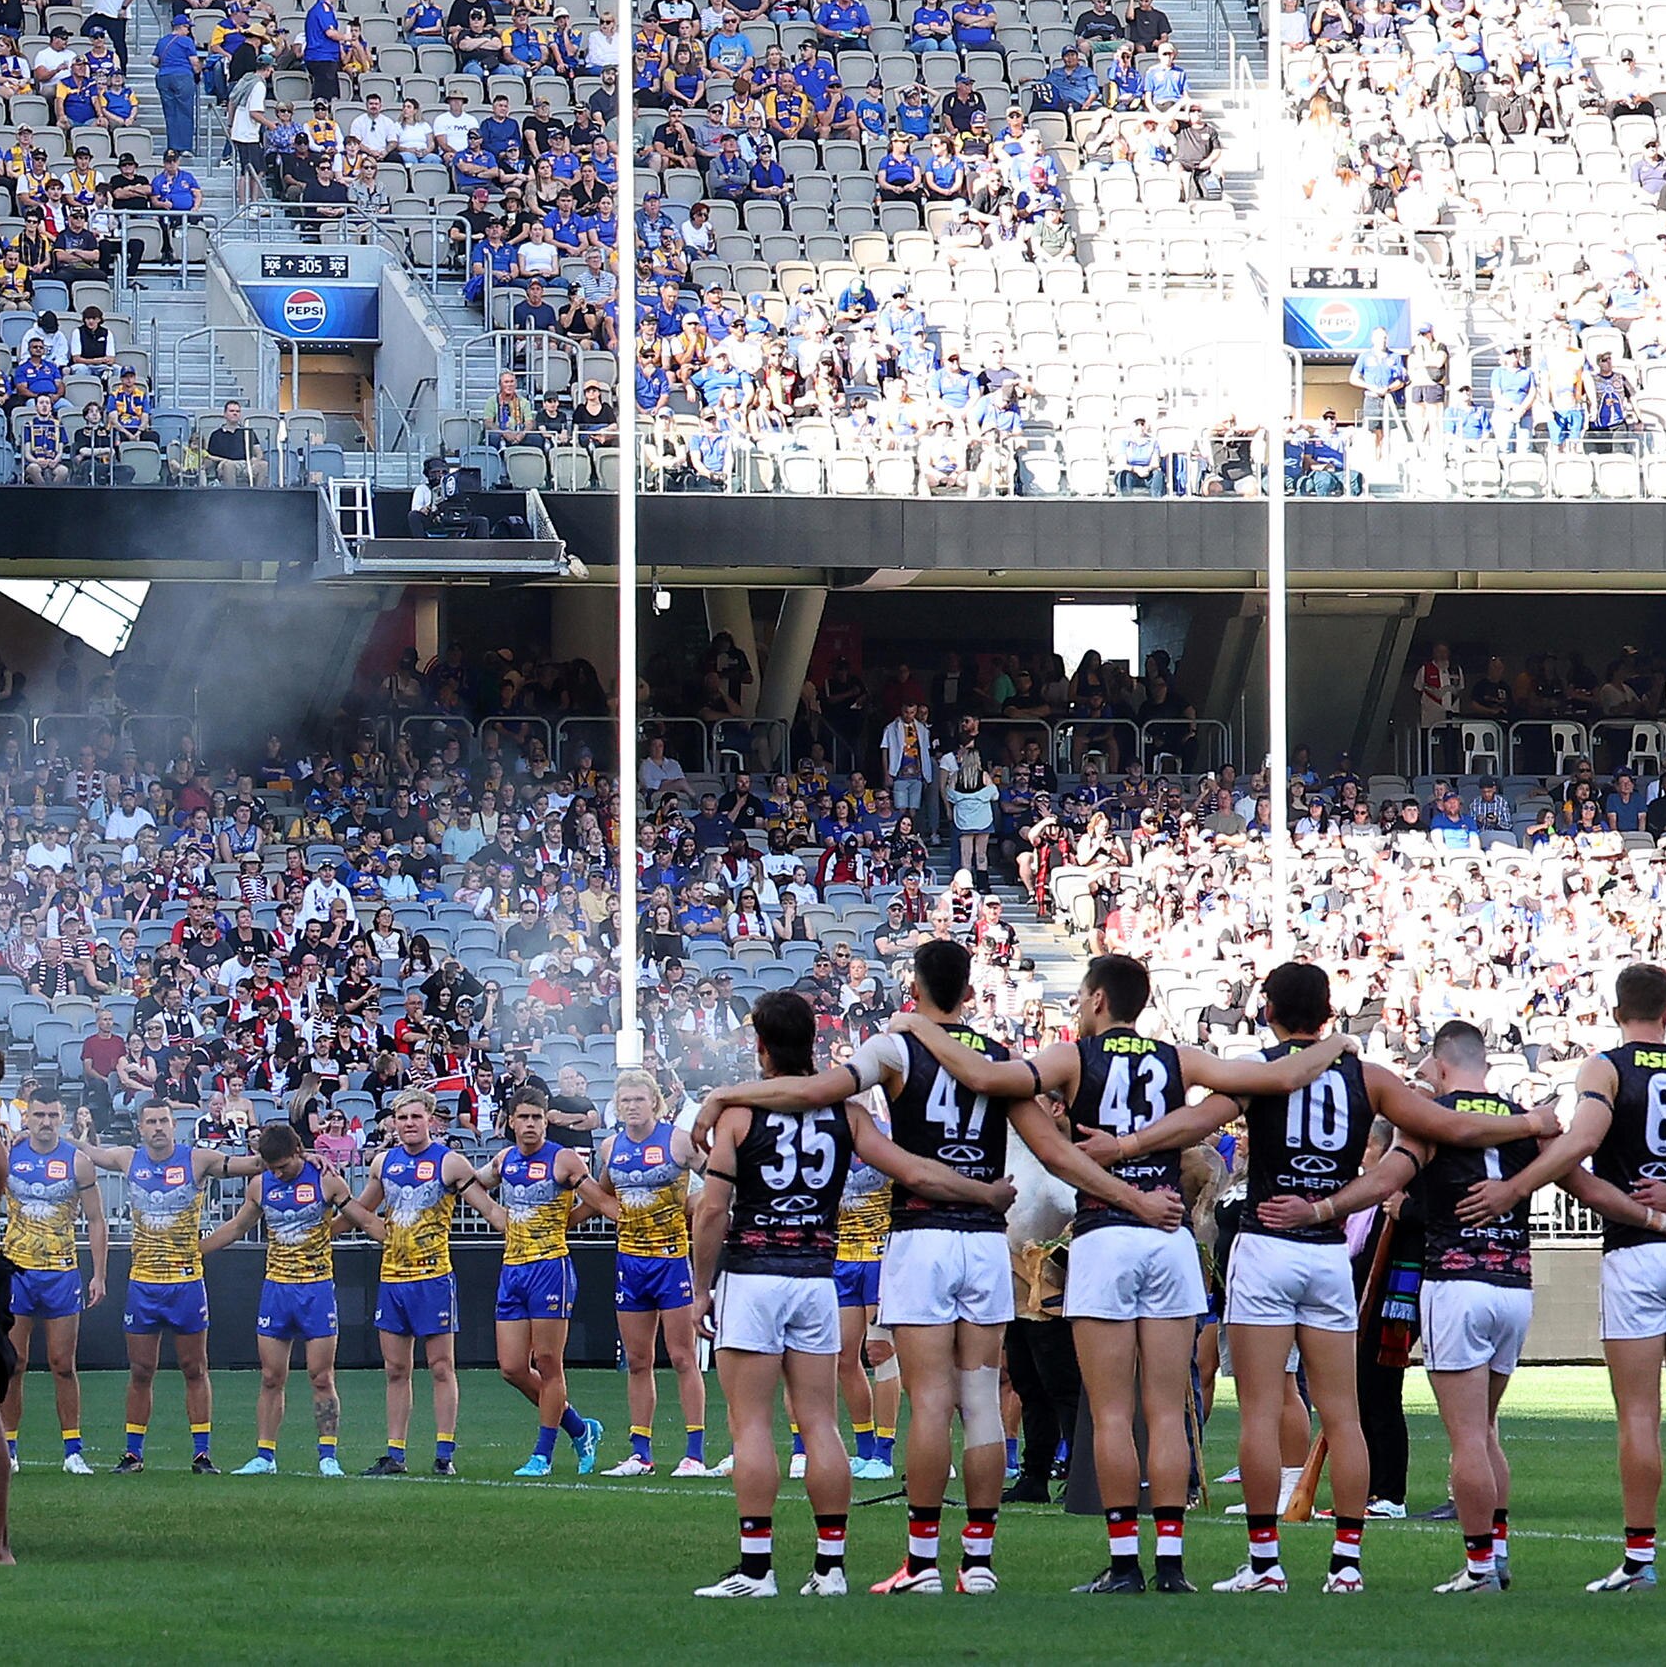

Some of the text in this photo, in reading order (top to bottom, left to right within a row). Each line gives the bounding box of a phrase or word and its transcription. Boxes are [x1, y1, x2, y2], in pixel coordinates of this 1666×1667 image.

[264, 259, 346, 274] 306 305 305
[286, 306, 324, 316] PEPSI
[1102, 1036, 1157, 1055] RSEA
[1098, 1054, 1169, 1138] 43
[1285, 1069, 1349, 1152] 10
[1455, 1099, 1511, 1116] RSEA
[760, 1107, 836, 1190] 35
[1110, 1165, 1167, 1178] HERY
[1277, 1175, 1348, 1189] CHERY
[201, 1230, 213, 1239] 10
[1460, 1227, 1525, 1240] CHERY
